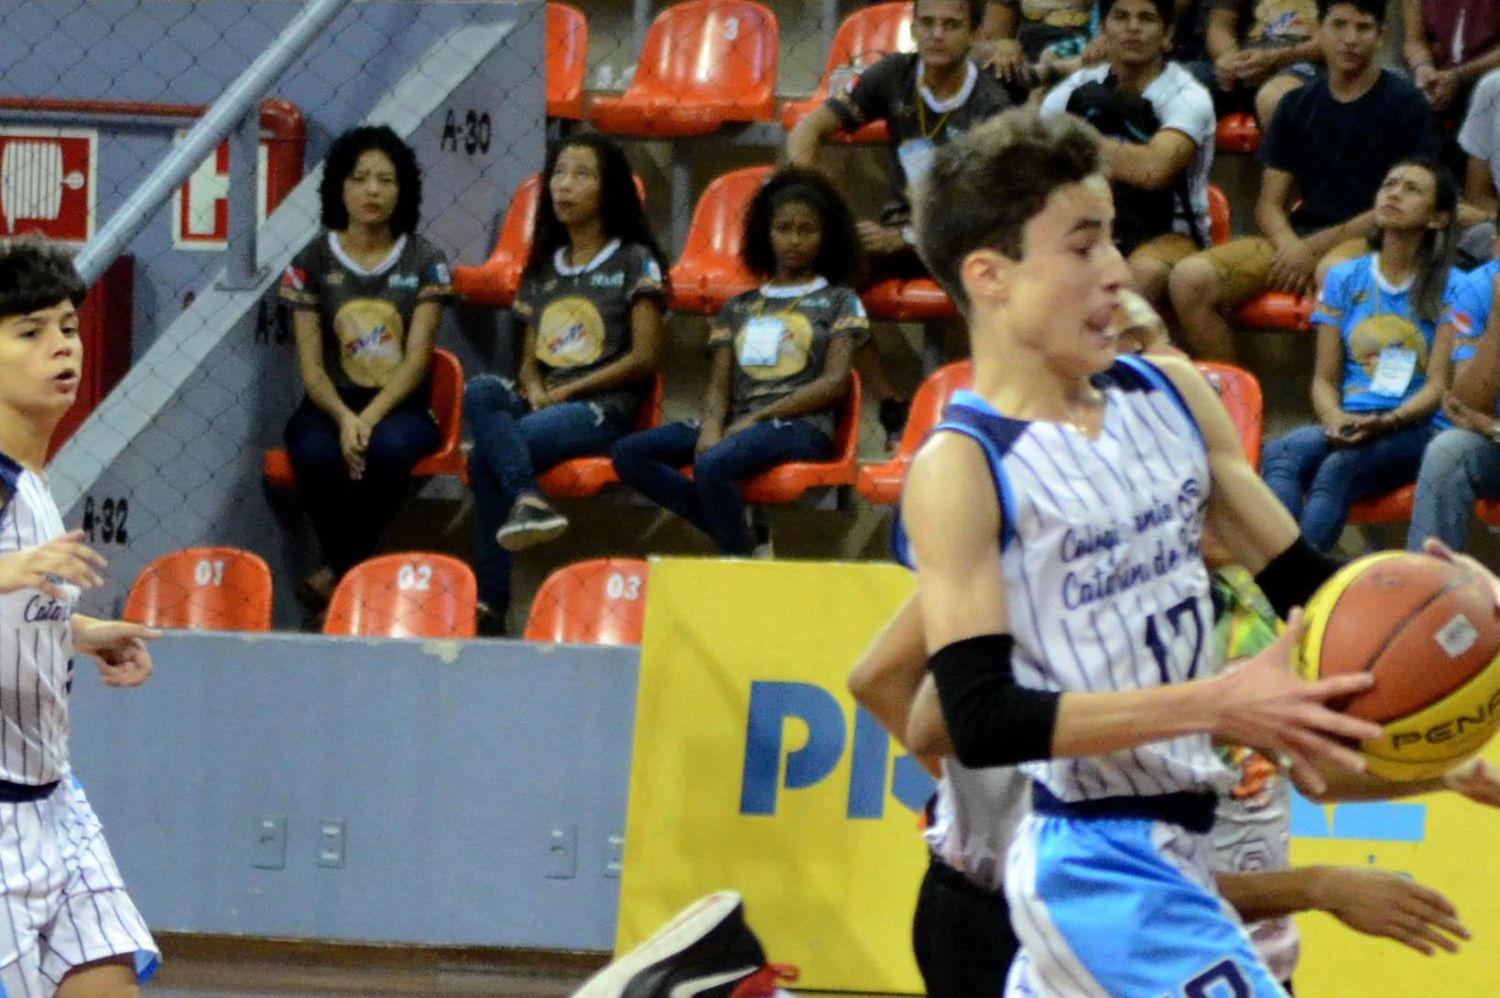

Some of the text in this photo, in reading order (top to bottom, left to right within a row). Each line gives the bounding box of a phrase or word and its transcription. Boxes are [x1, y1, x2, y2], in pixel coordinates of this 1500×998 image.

[441, 109, 491, 154] A-30
[83, 497, 128, 544] A-32
[195, 560, 225, 585] 01
[398, 565, 432, 591] 02
[606, 574, 641, 600] 03
